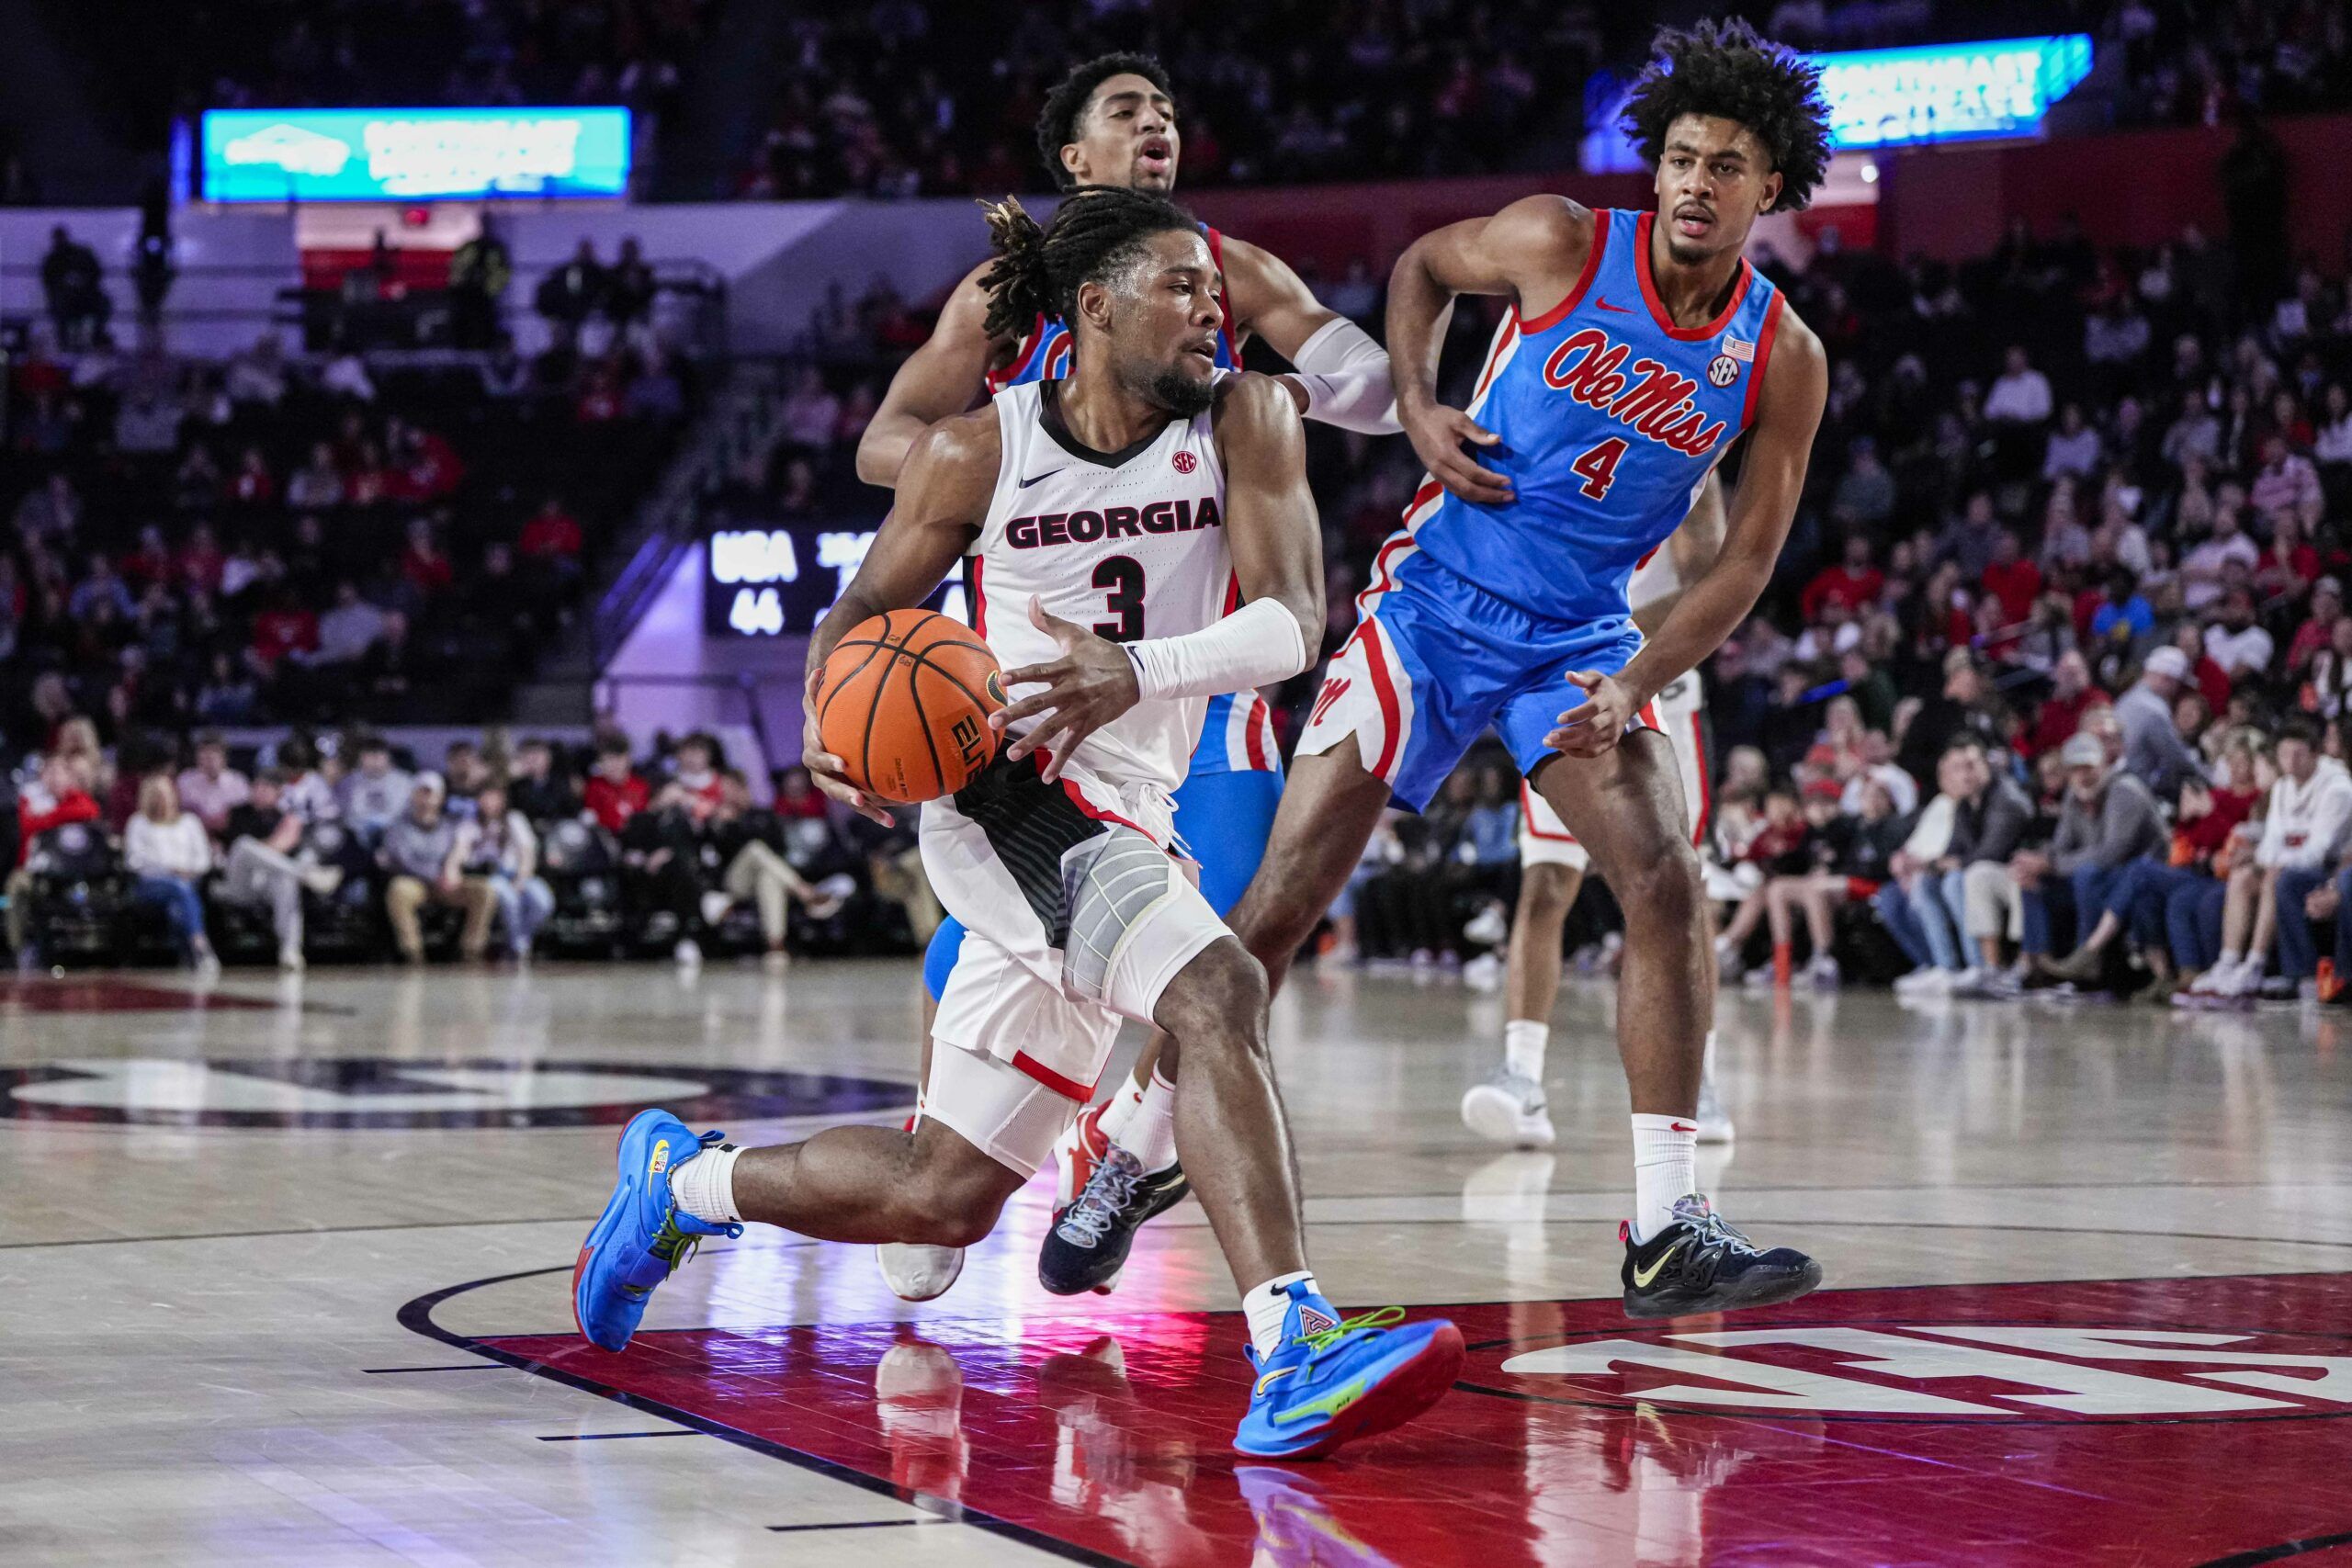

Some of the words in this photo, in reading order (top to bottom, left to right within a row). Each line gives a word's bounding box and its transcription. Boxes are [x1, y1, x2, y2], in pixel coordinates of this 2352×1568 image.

[1543, 327, 1631, 408] Ole
[1607, 358, 1726, 457] Miss
[1708, 355, 1739, 387] SEC
[1173, 452, 1195, 473] SEC
[1569, 436, 1629, 502] 4
[1005, 496, 1221, 549] GEORGIA
[1091, 555, 1146, 643] 3
